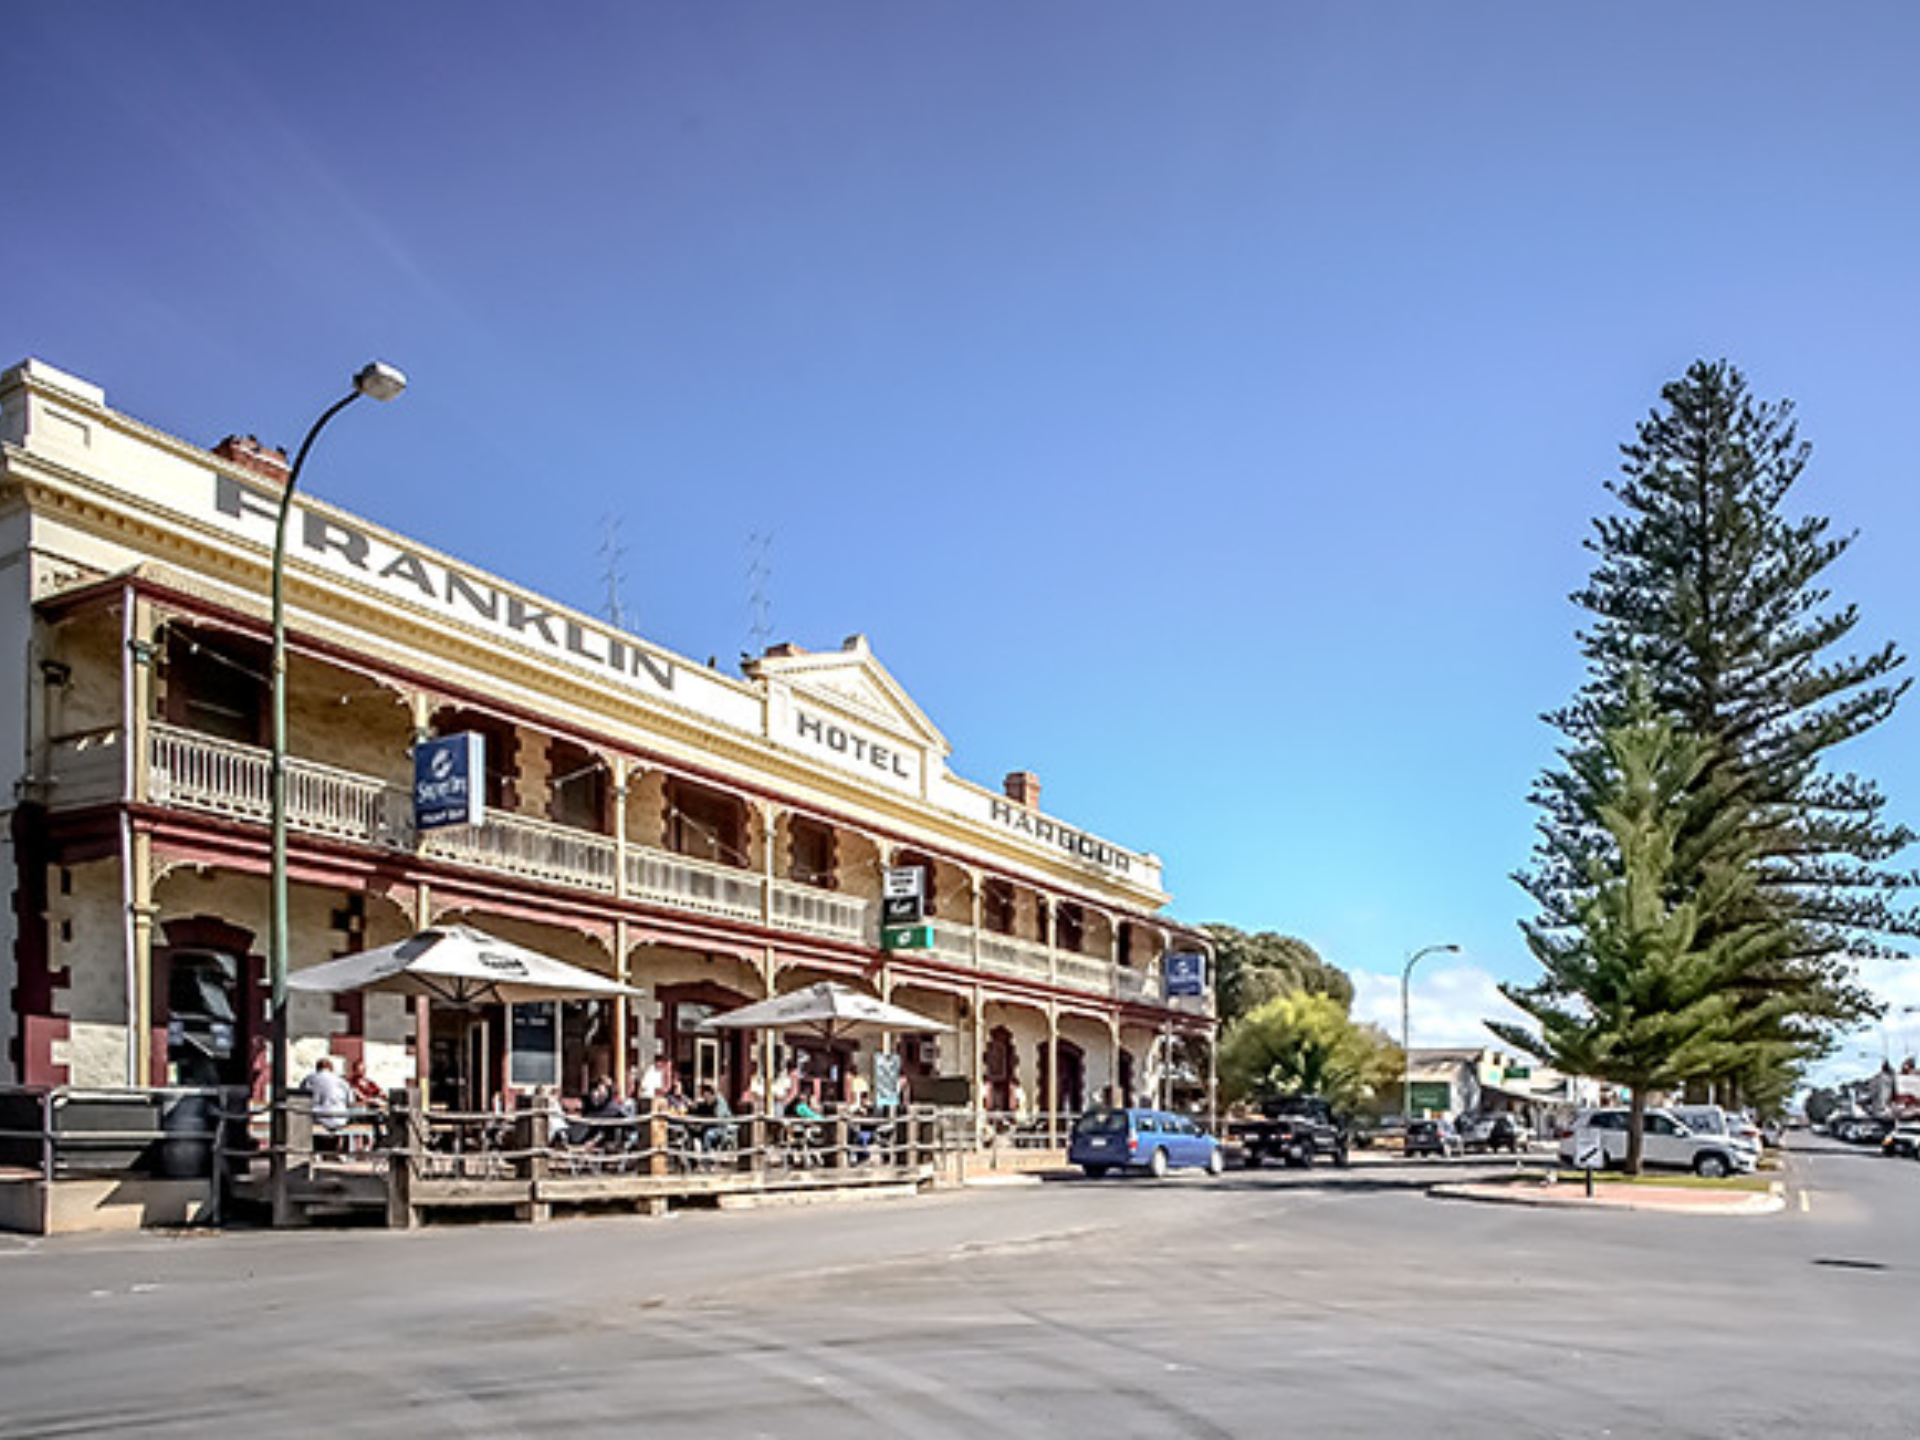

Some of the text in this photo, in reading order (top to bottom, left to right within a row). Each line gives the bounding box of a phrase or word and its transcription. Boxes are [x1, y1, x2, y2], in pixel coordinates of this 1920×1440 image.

[215, 471, 675, 691] FRANKLIN
[797, 710, 908, 778] HOTEL
[991, 799, 1130, 873] HARBOUR
